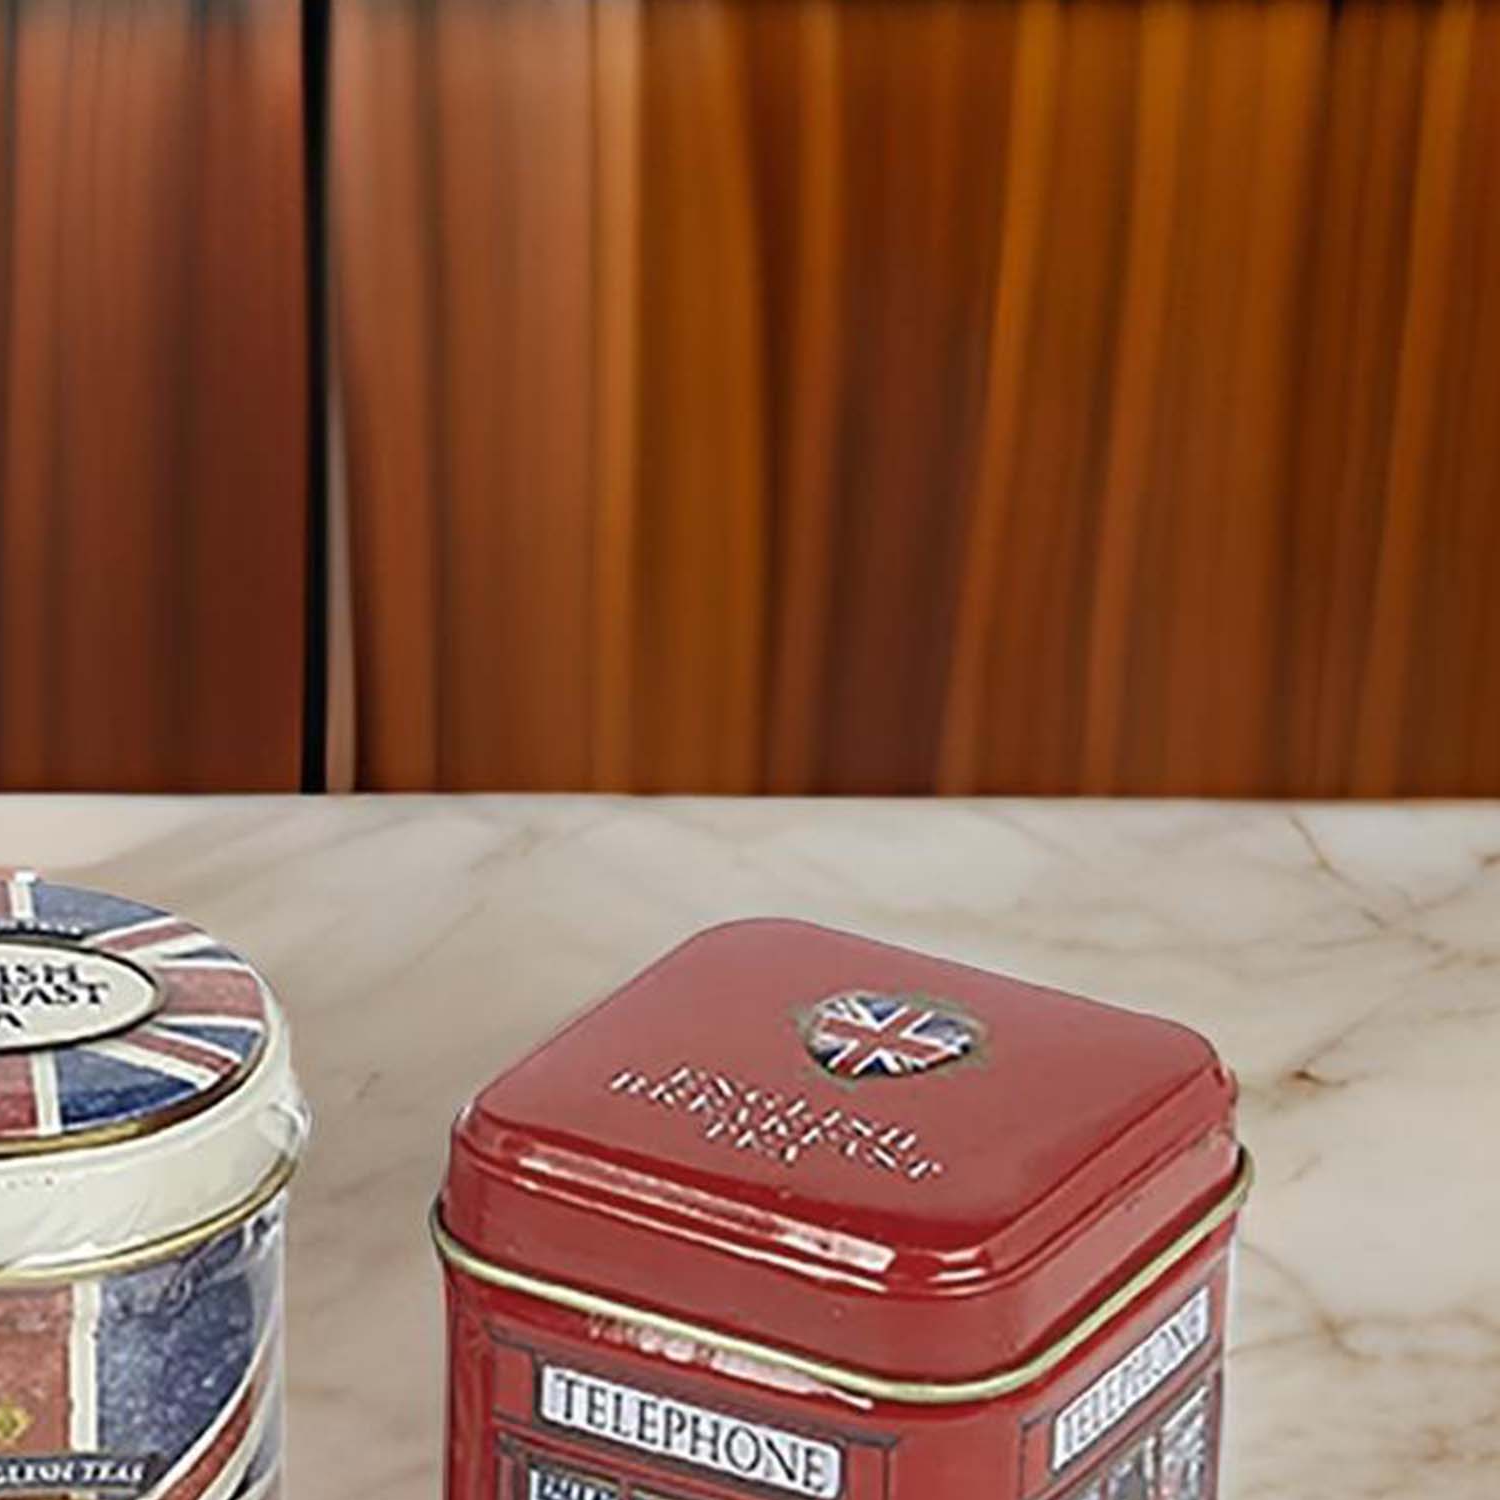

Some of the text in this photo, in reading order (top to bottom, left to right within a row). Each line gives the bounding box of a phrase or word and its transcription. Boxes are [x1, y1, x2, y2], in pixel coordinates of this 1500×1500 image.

[609, 1071, 944, 1178] BREAKFAST
[668, 1066, 919, 1151] ENGLISH
[703, 1116, 800, 1162] TEA
[1061, 1298, 1205, 1452] TELEPHONE
[79, 1459, 145, 1484] TEAS
[553, 1371, 831, 1493] TELEPHONE
